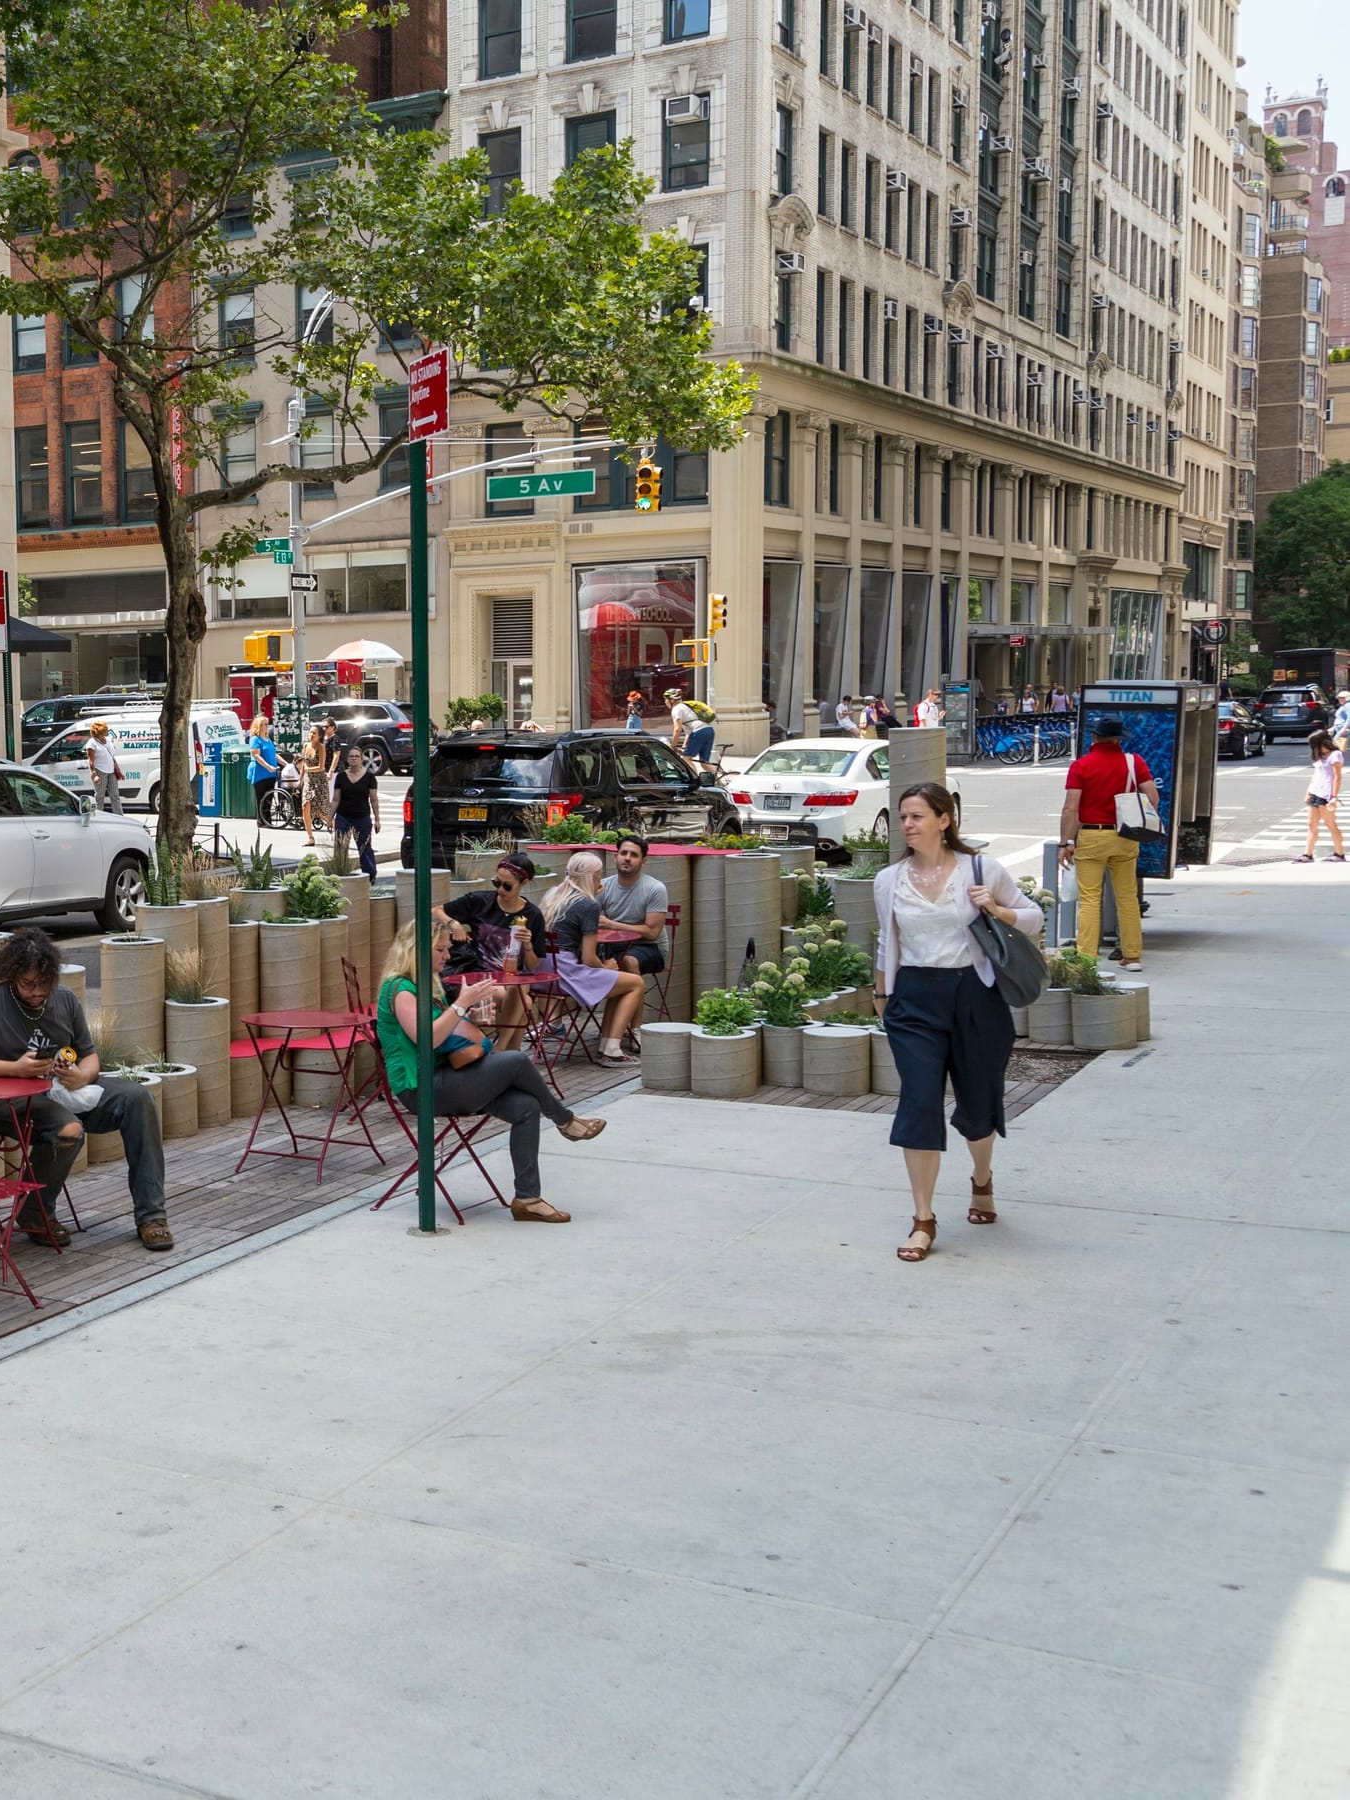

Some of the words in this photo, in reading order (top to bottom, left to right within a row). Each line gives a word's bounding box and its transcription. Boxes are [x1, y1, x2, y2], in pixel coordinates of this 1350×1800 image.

[418, 360, 441, 383] STANDING
[412, 385, 430, 404] Anytime
[519, 480, 530, 494] 5
[538, 478, 563, 493] Av
[265, 541, 271, 552] 5
[640, 606, 673, 622] SCHOOL
[1108, 690, 1154, 703] TITAN
